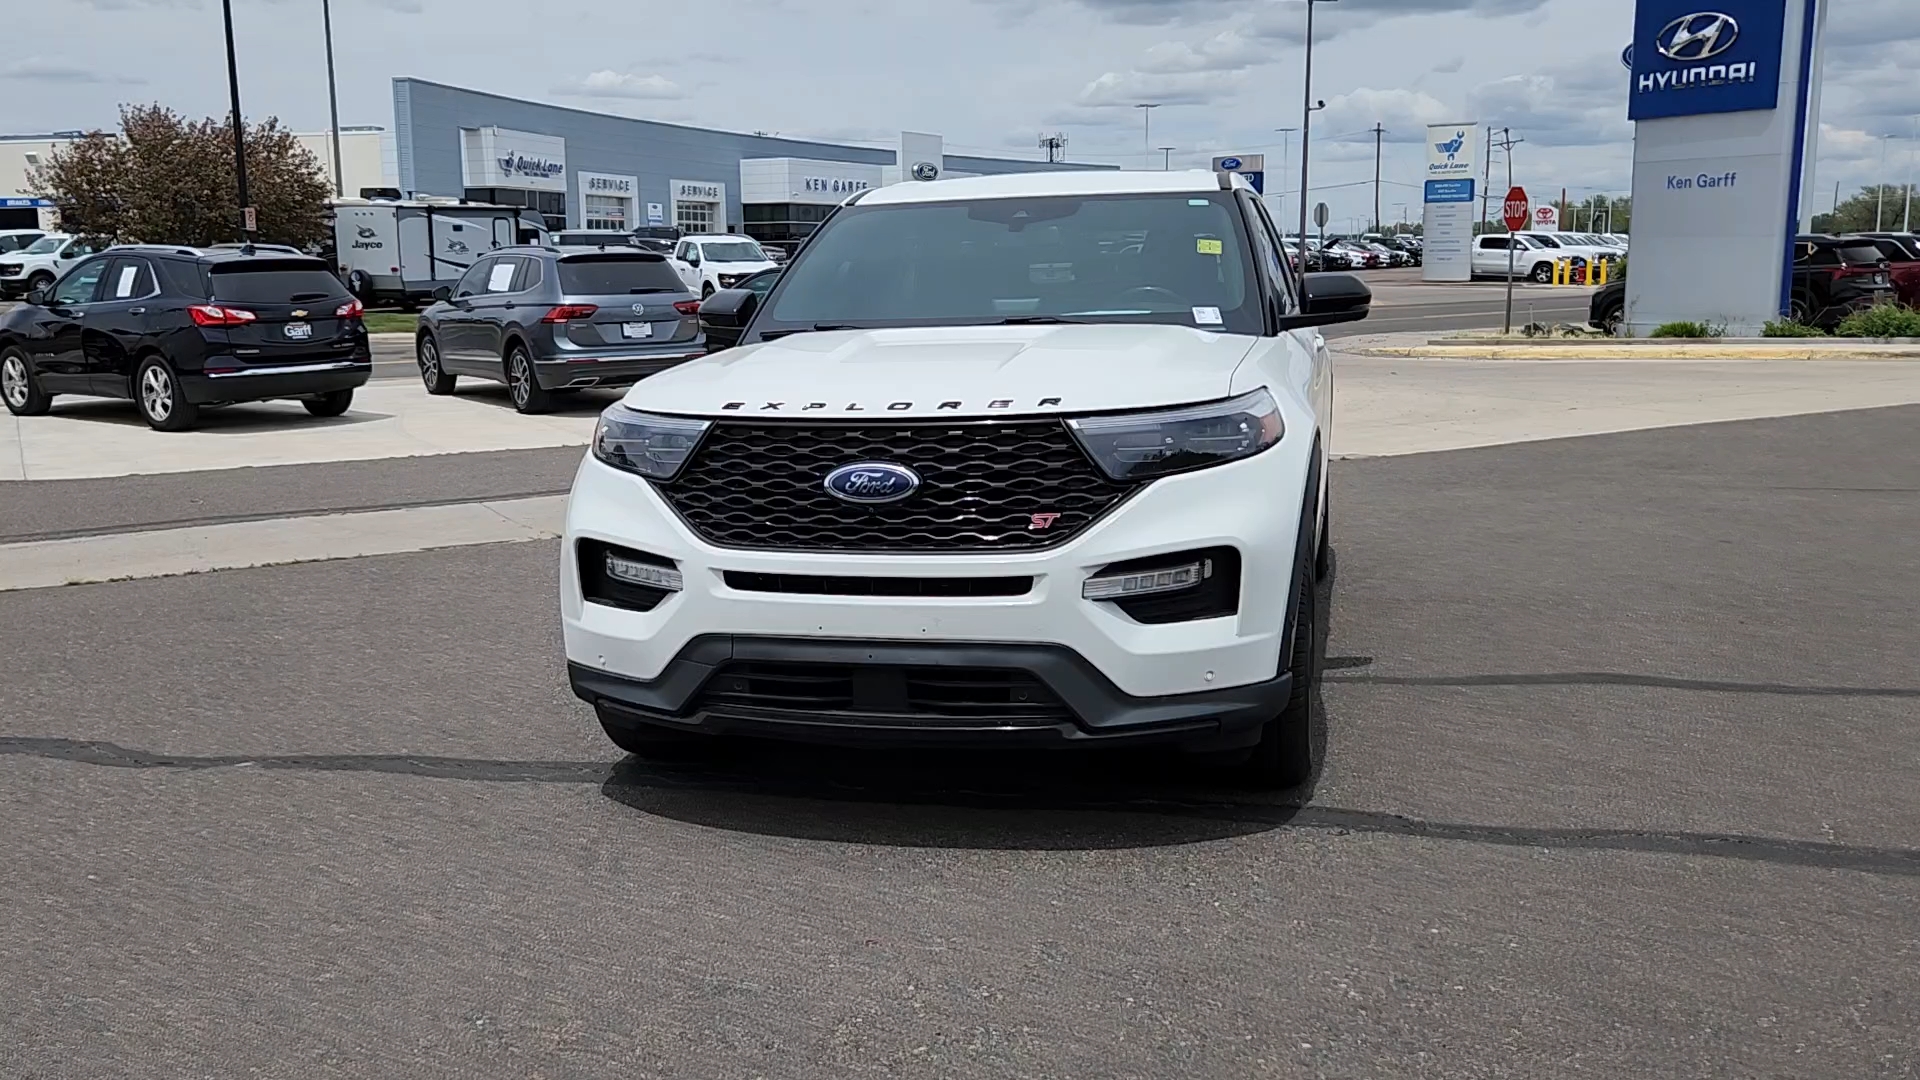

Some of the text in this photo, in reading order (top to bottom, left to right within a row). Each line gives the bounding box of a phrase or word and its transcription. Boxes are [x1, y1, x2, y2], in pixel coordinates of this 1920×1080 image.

[1638, 62, 1756, 93] HYUNDAI
[516, 156, 563, 174] Quick Lane
[1429, 162, 1448, 170] Quick
[589, 177, 631, 191] SERVICE
[805, 178, 868, 193] KEN GARFF
[1667, 172, 1737, 189] Ken Garff
[680, 185, 719, 197] SERVICE
[1504, 200, 1527, 218] STOP
[351, 240, 383, 250] Jayco
[721, 397, 1062, 410] EXPLORER
[845, 471, 896, 494] Ford
[1029, 512, 1061, 529] ST
